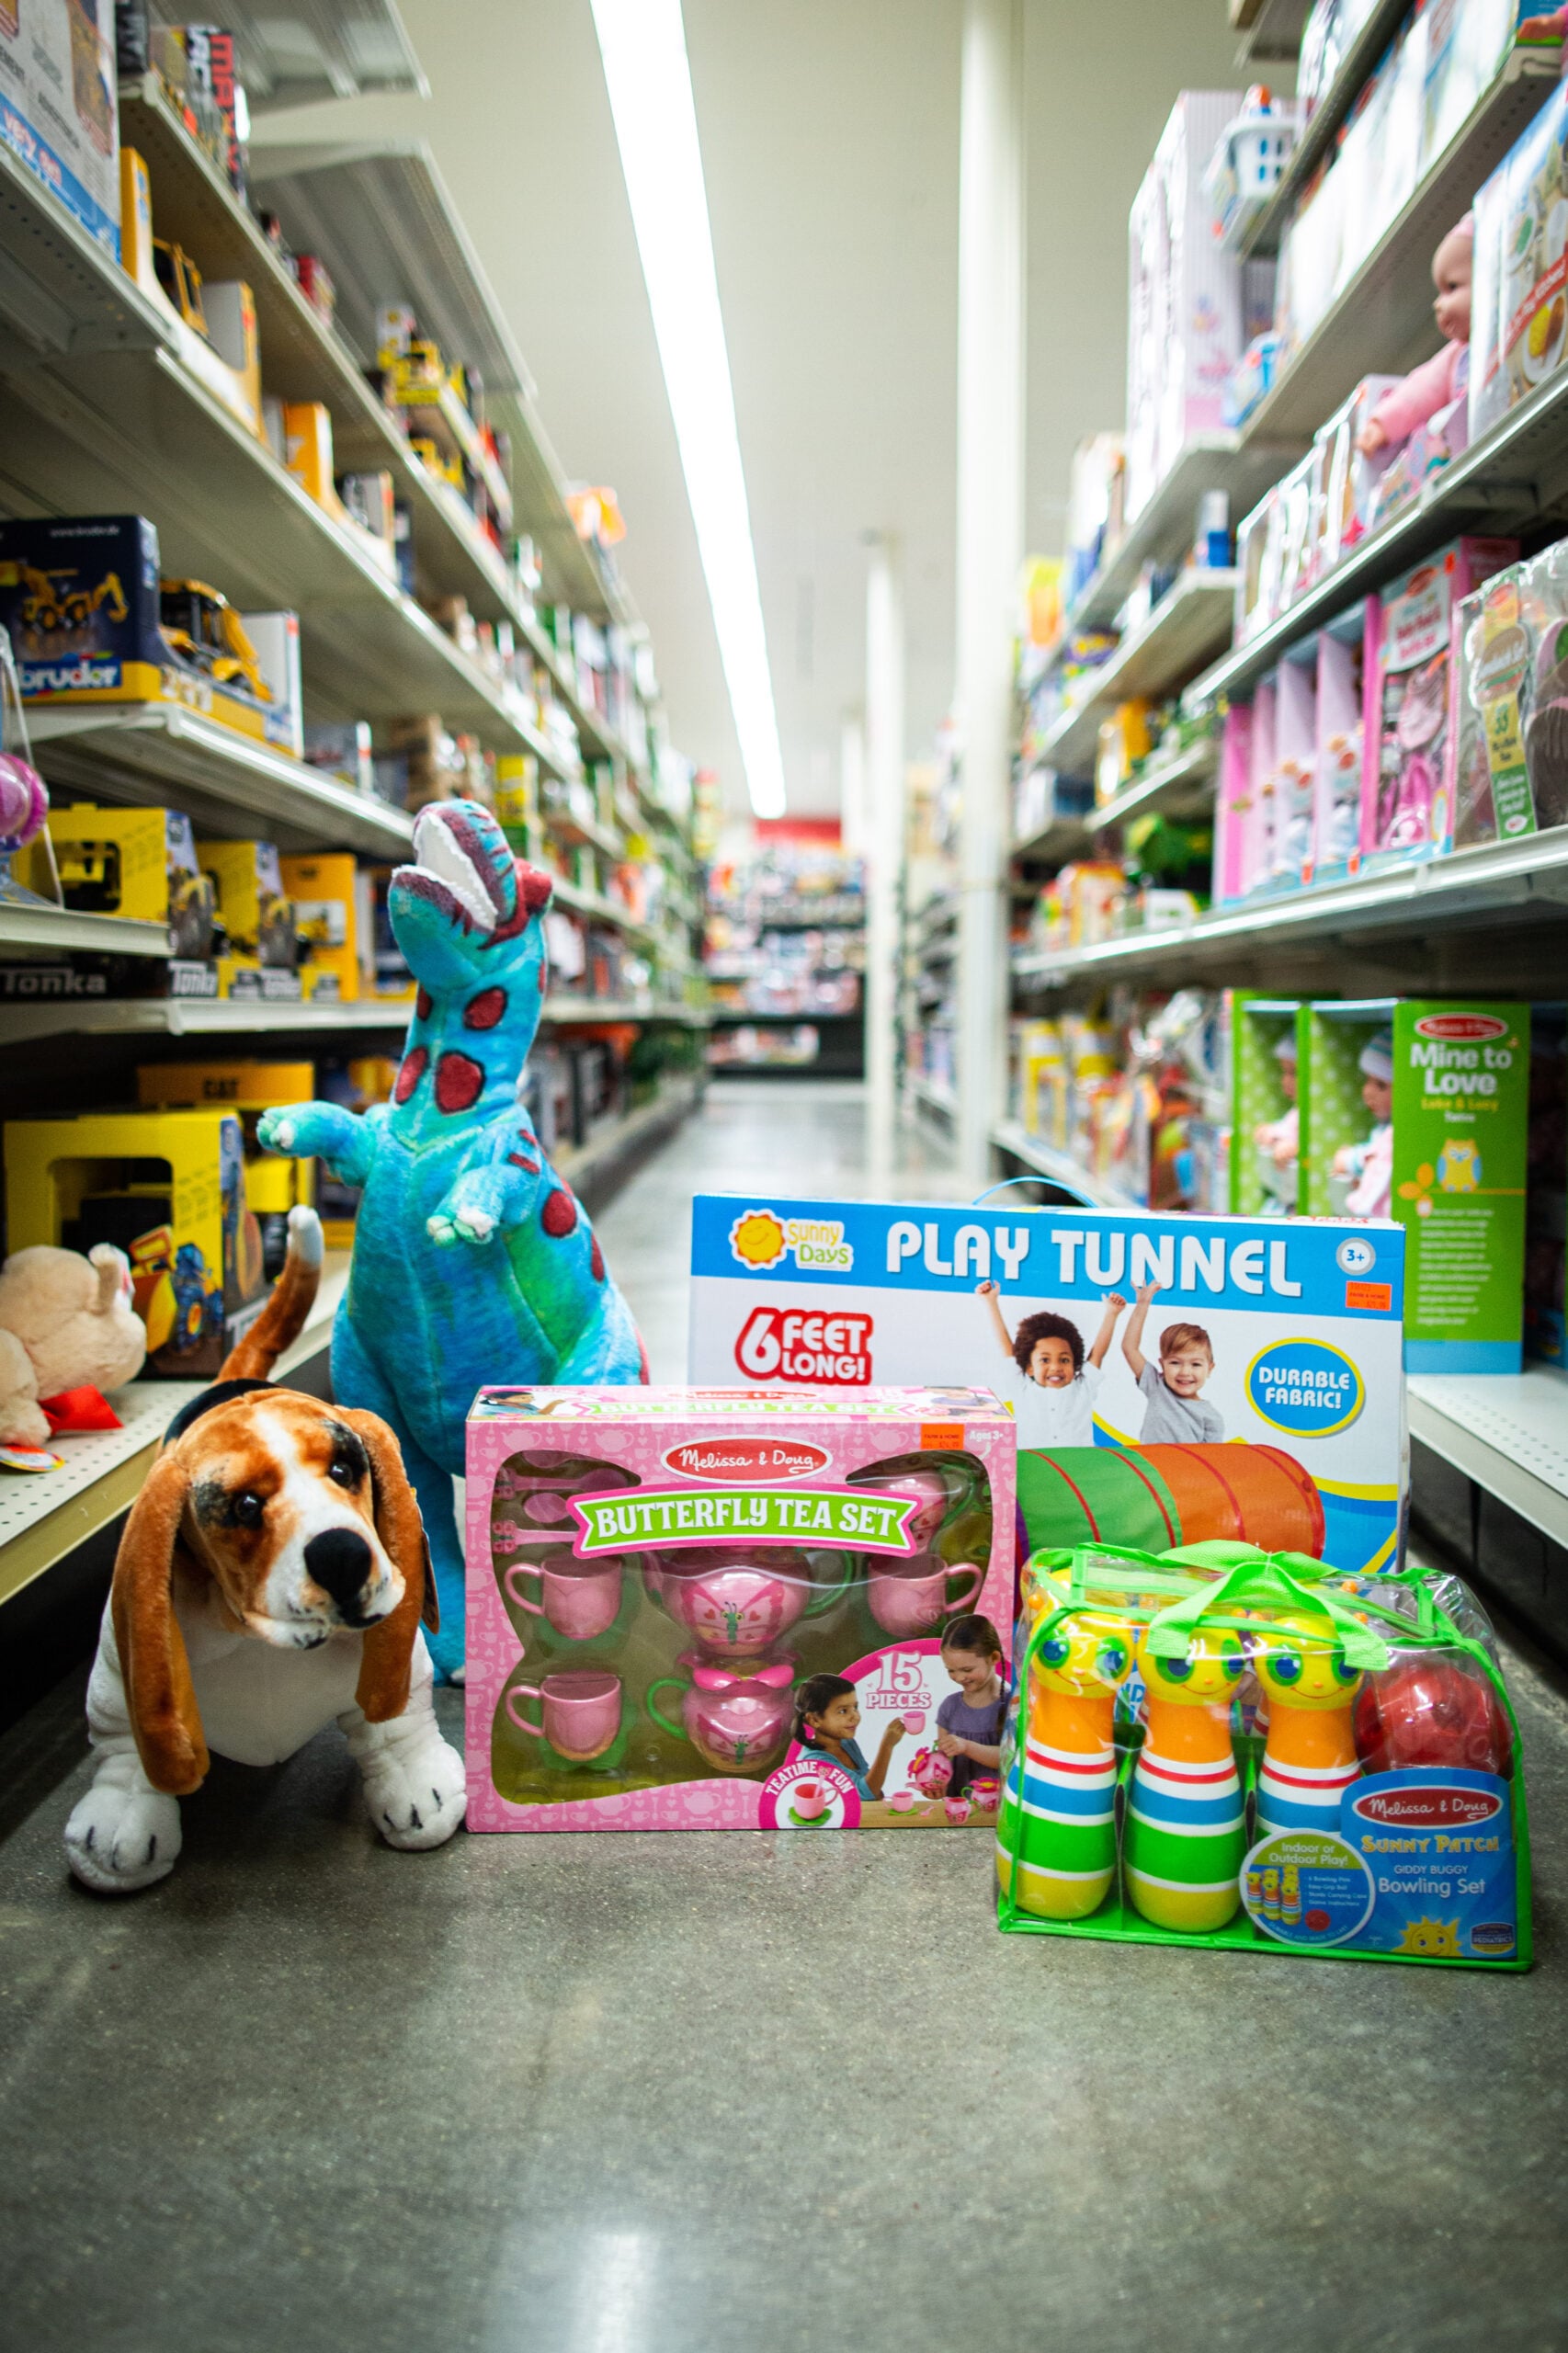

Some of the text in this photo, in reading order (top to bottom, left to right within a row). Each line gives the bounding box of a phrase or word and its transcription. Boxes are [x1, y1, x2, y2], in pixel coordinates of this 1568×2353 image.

[18, 660, 120, 689] bruder
[0, 967, 108, 995] Tonka
[1411, 1042, 1513, 1070] Mine to
[203, 1079, 238, 1100] CAT
[1425, 1069, 1498, 1096] Love
[787, 1222, 840, 1246] Sunny
[799, 1244, 848, 1265] Days
[886, 1220, 1303, 1298] PLAY TUNNEL
[1346, 1248, 1366, 1262] 3+
[740, 1313, 868, 1374] 6 FEET
[781, 1350, 866, 1381] LONG!
[1258, 1366, 1350, 1391] DURABLE
[775, 1403, 828, 1413] TEA
[835, 1404, 890, 1414] SET
[1265, 1386, 1342, 1410] FABRIC!
[969, 1430, 992, 1442] Ages
[678, 1448, 814, 1474] Melissa & Doug
[595, 1497, 898, 1539] BUTTERFLY TEA SET
[877, 1652, 923, 1693] 15
[866, 1692, 932, 1710] PIECES
[764, 1761, 855, 1796] TEATIME FUN
[1369, 1797, 1490, 1820] Melissa & Doug
[1268, 1852, 1348, 1868] Outdoor Play!
[1281, 1842, 1335, 1854] Indoor or
[1393, 1864, 1469, 1875] GIDDY BUGGY
[1379, 1876, 1486, 1898] Bowling Set
